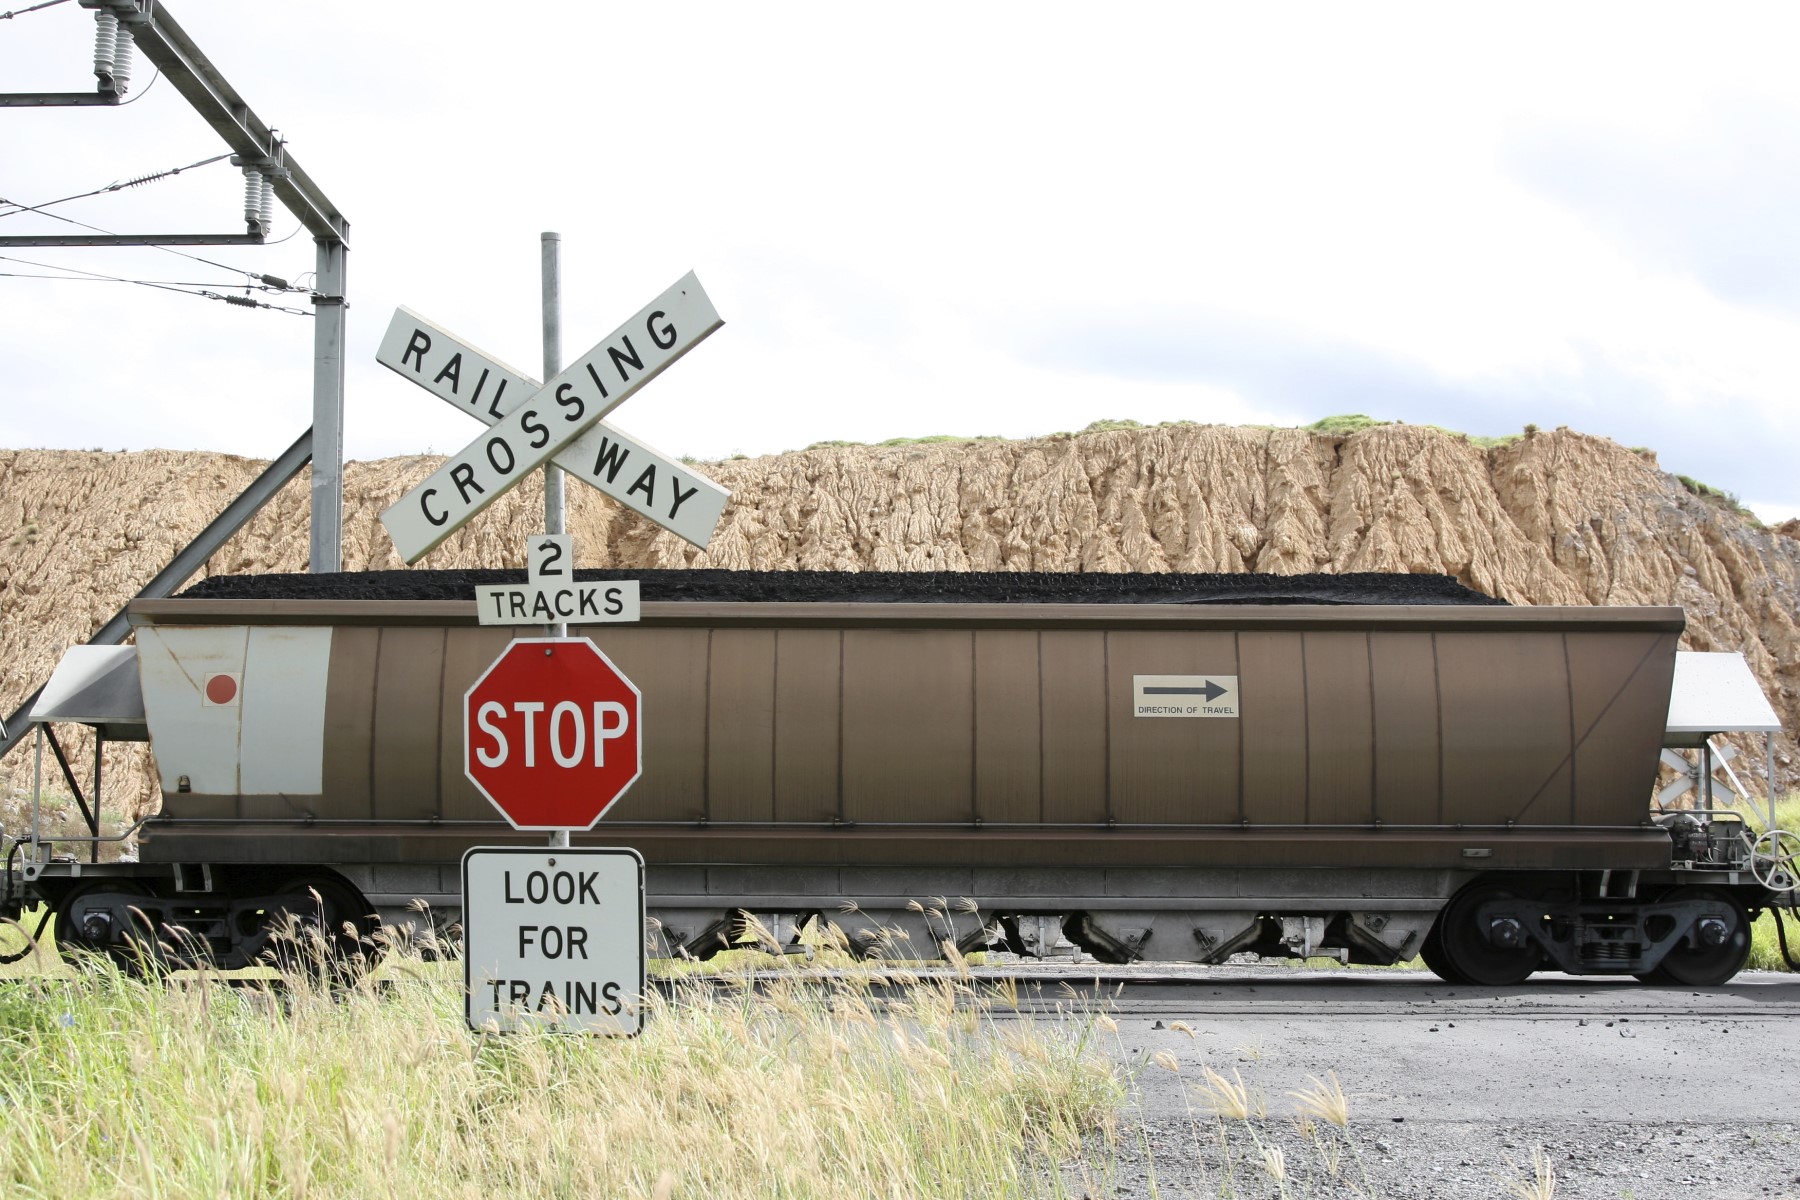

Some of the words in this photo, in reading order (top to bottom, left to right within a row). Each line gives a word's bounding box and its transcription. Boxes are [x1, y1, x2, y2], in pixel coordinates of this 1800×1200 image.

[401, 328, 507, 420] RAIL
[420, 310, 678, 527] CROSSING
[593, 436, 699, 520] WAY
[538, 542, 563, 576] 2
[490, 588, 624, 618] TRACKS
[1138, 706, 1183, 714] DIRECTION
[1186, 706, 1198, 714] OF
[1202, 706, 1234, 714] TRAVEL
[476, 701, 629, 769] STOP
[504, 871, 601, 905] LOOK
[519, 926, 588, 960] FOR
[487, 980, 622, 1016] TRAINS
